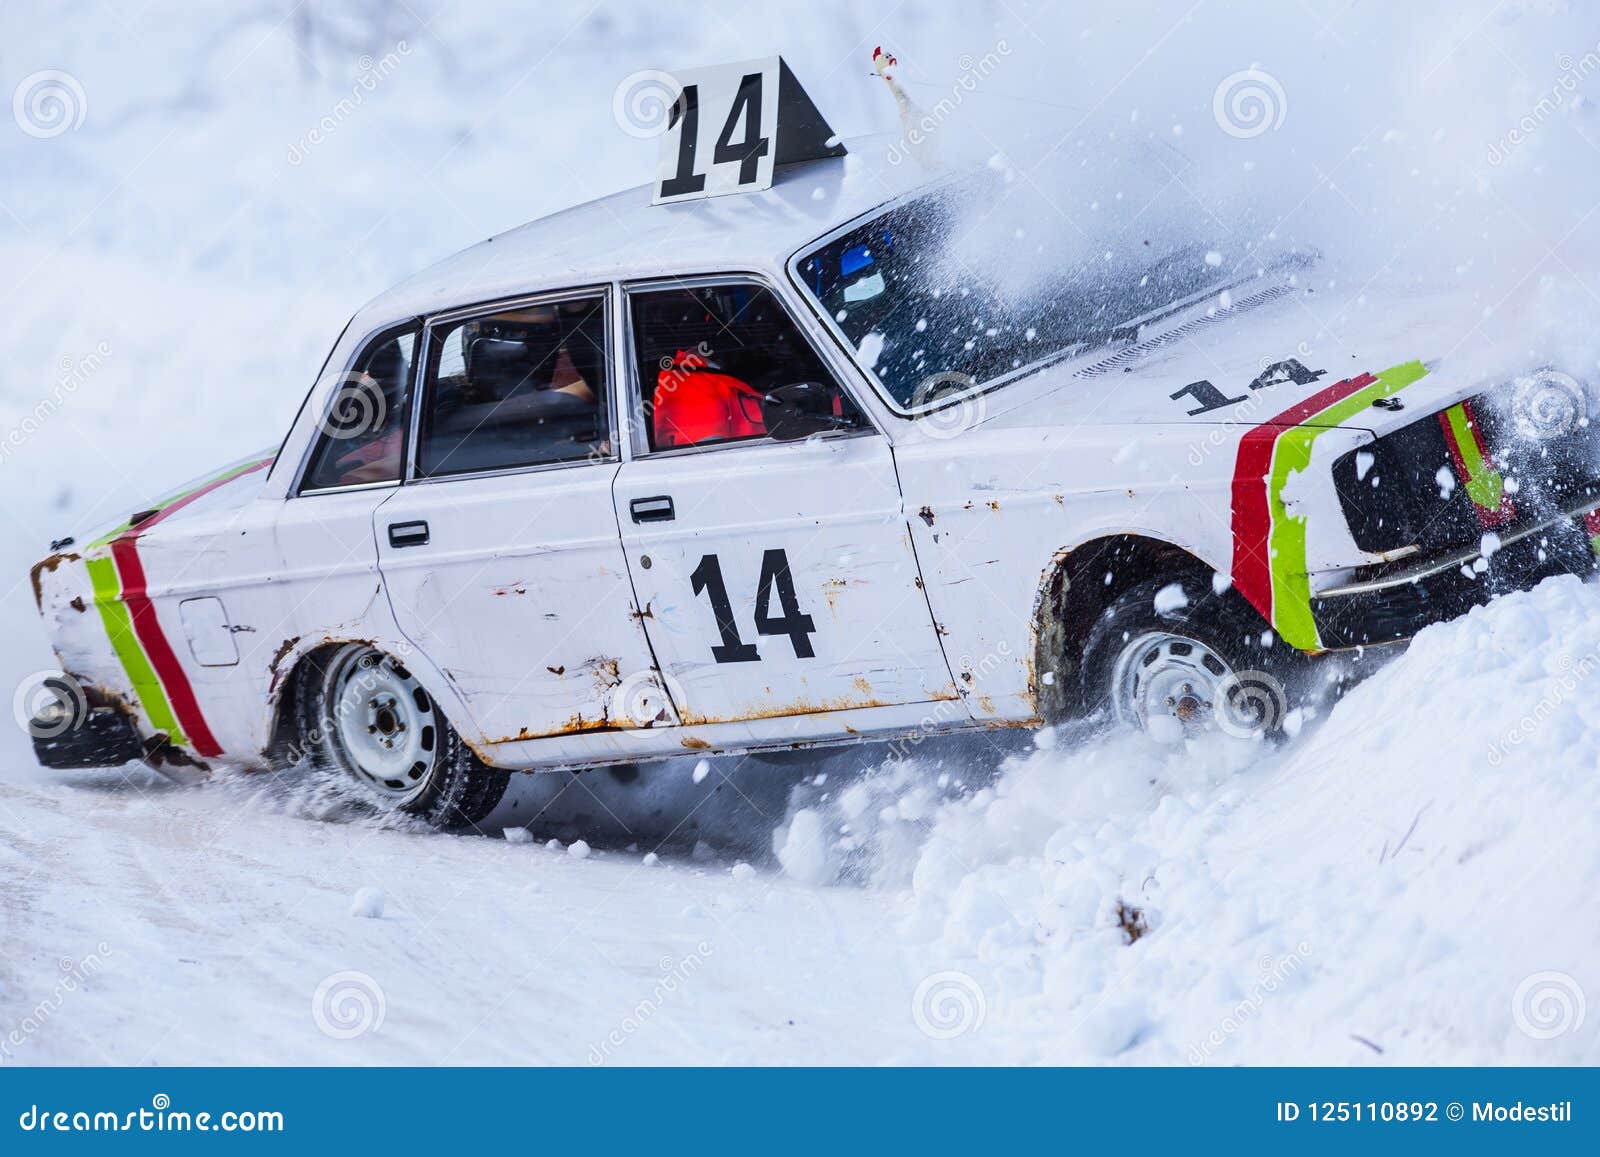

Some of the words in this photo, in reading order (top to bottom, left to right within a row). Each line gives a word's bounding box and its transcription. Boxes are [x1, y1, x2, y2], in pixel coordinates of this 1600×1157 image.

[660, 72, 769, 198] 14
[1169, 358, 1328, 416] 14
[690, 548, 816, 663] 14
